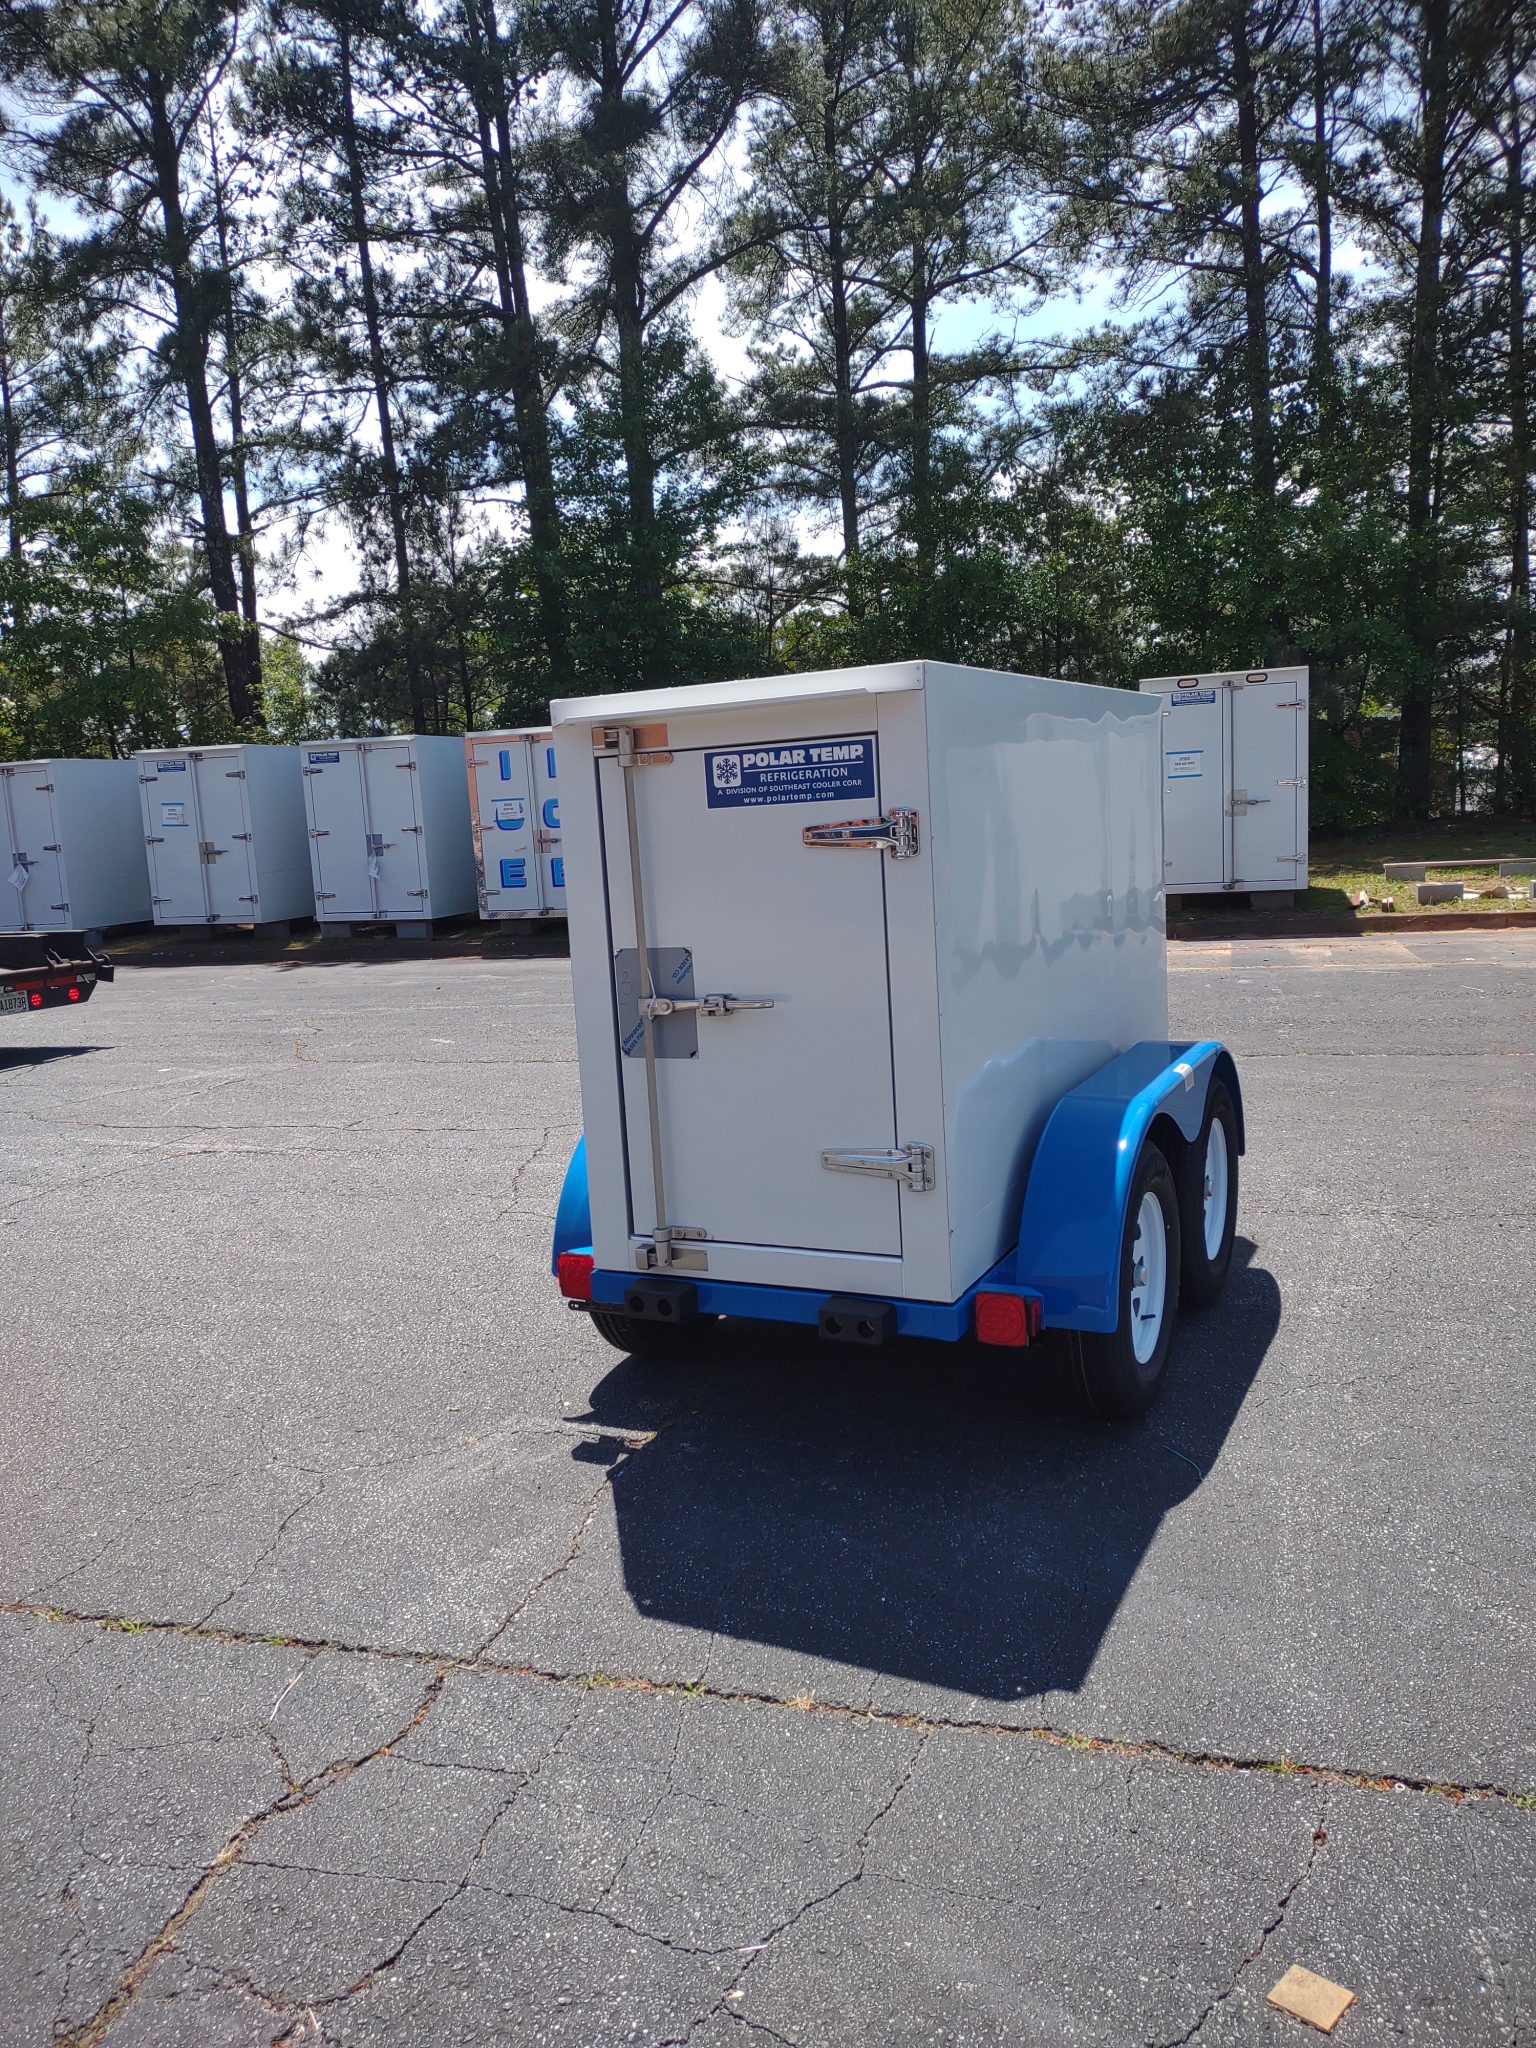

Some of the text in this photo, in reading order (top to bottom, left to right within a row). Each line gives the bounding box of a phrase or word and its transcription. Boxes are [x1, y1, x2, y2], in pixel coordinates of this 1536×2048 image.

[743, 745, 863, 767] POLAR TEMP
[760, 768, 848, 782] REFRIGERATION
[726, 786, 757, 795] DIVISION
[769, 782, 811, 792] SOUTHEAST
[812, 780, 841, 789] COOLER
[743, 791, 835, 803] www.polartemp.com
